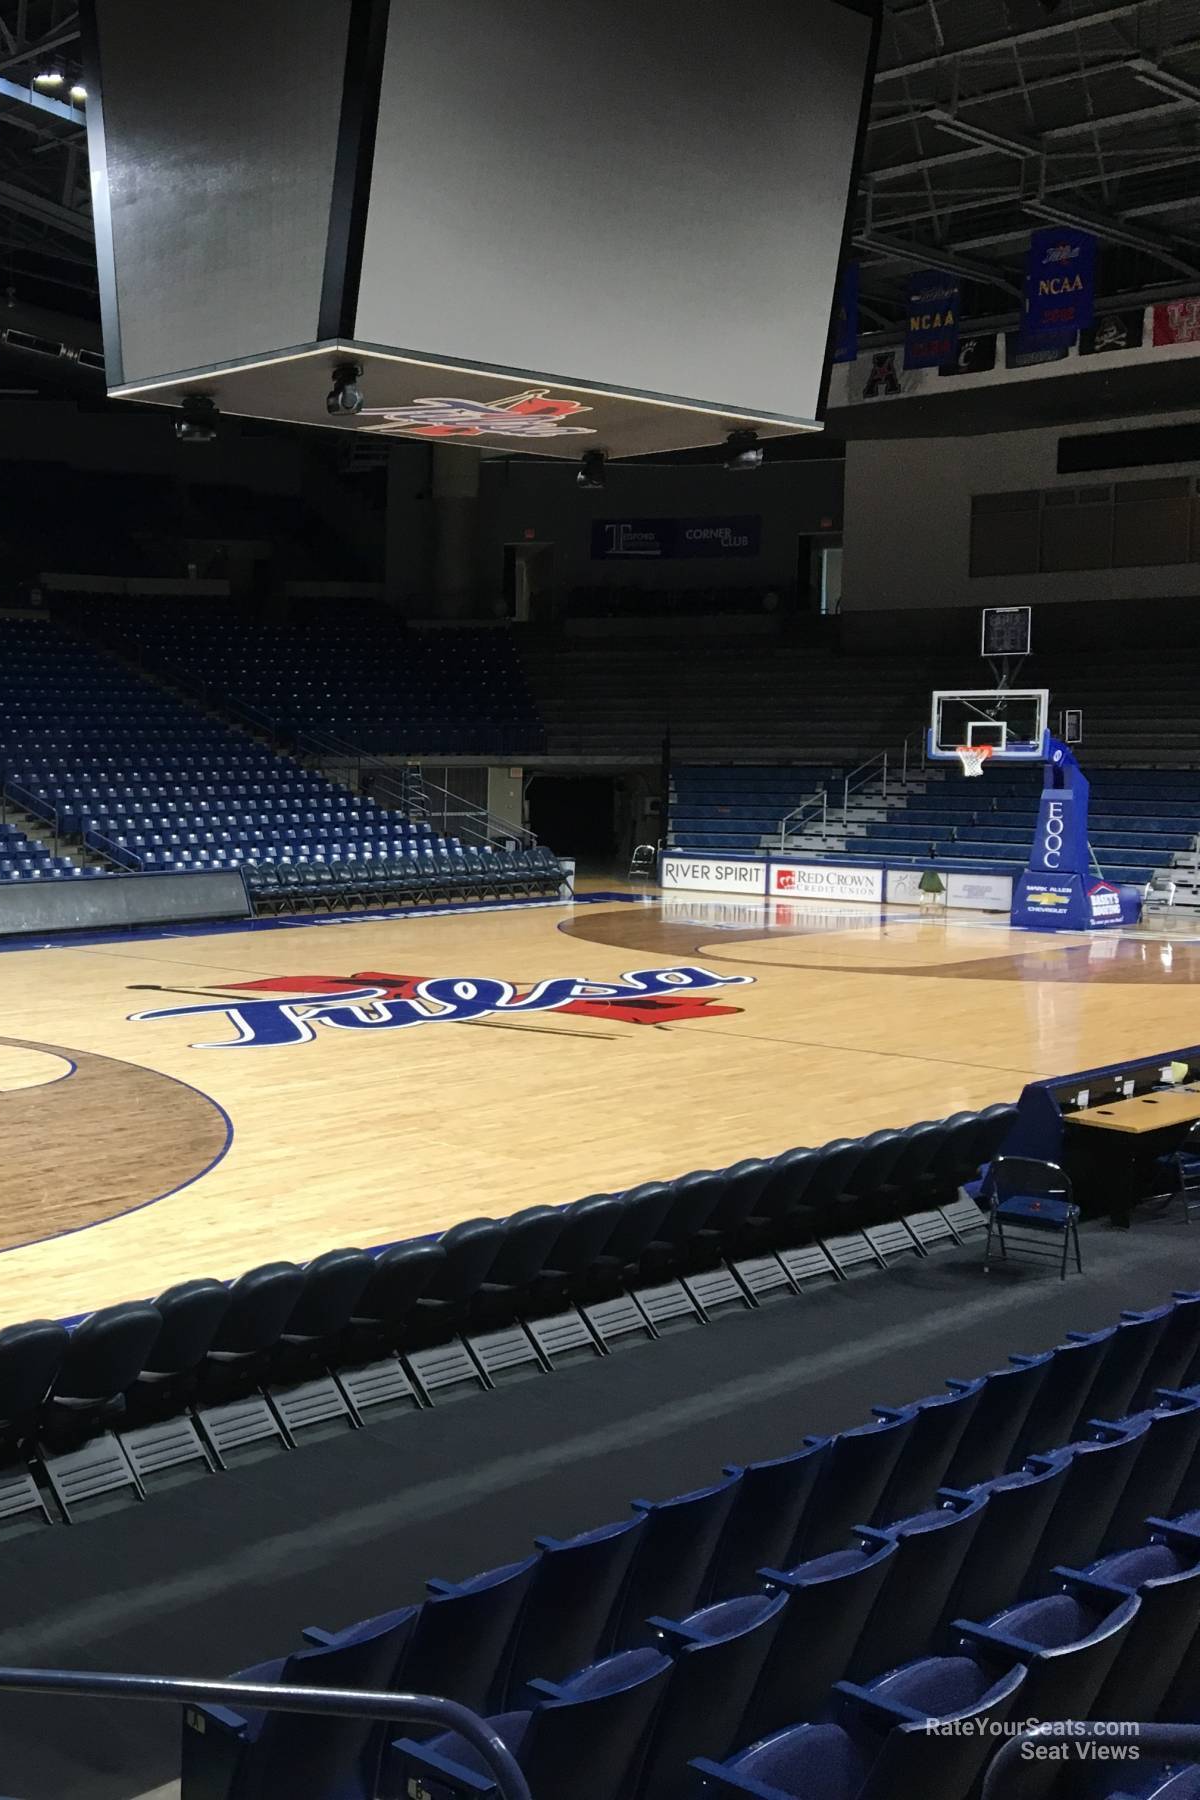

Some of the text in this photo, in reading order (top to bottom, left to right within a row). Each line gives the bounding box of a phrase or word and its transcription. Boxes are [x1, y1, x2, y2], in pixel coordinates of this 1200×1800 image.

[1038, 273, 1084, 296] NCAA
[910, 309, 955, 331] NCAA
[685, 528, 732, 541] CORNER
[720, 536, 750, 548] CLUB
[665, 863, 761, 884] RIVER SPIRIT
[797, 870, 875, 888] RED CROWN
[796, 884, 875, 896] CREDIT UNION
[1027, 906, 1068, 914] CHEVROLET
[126, 966, 757, 1049] Tulsa
